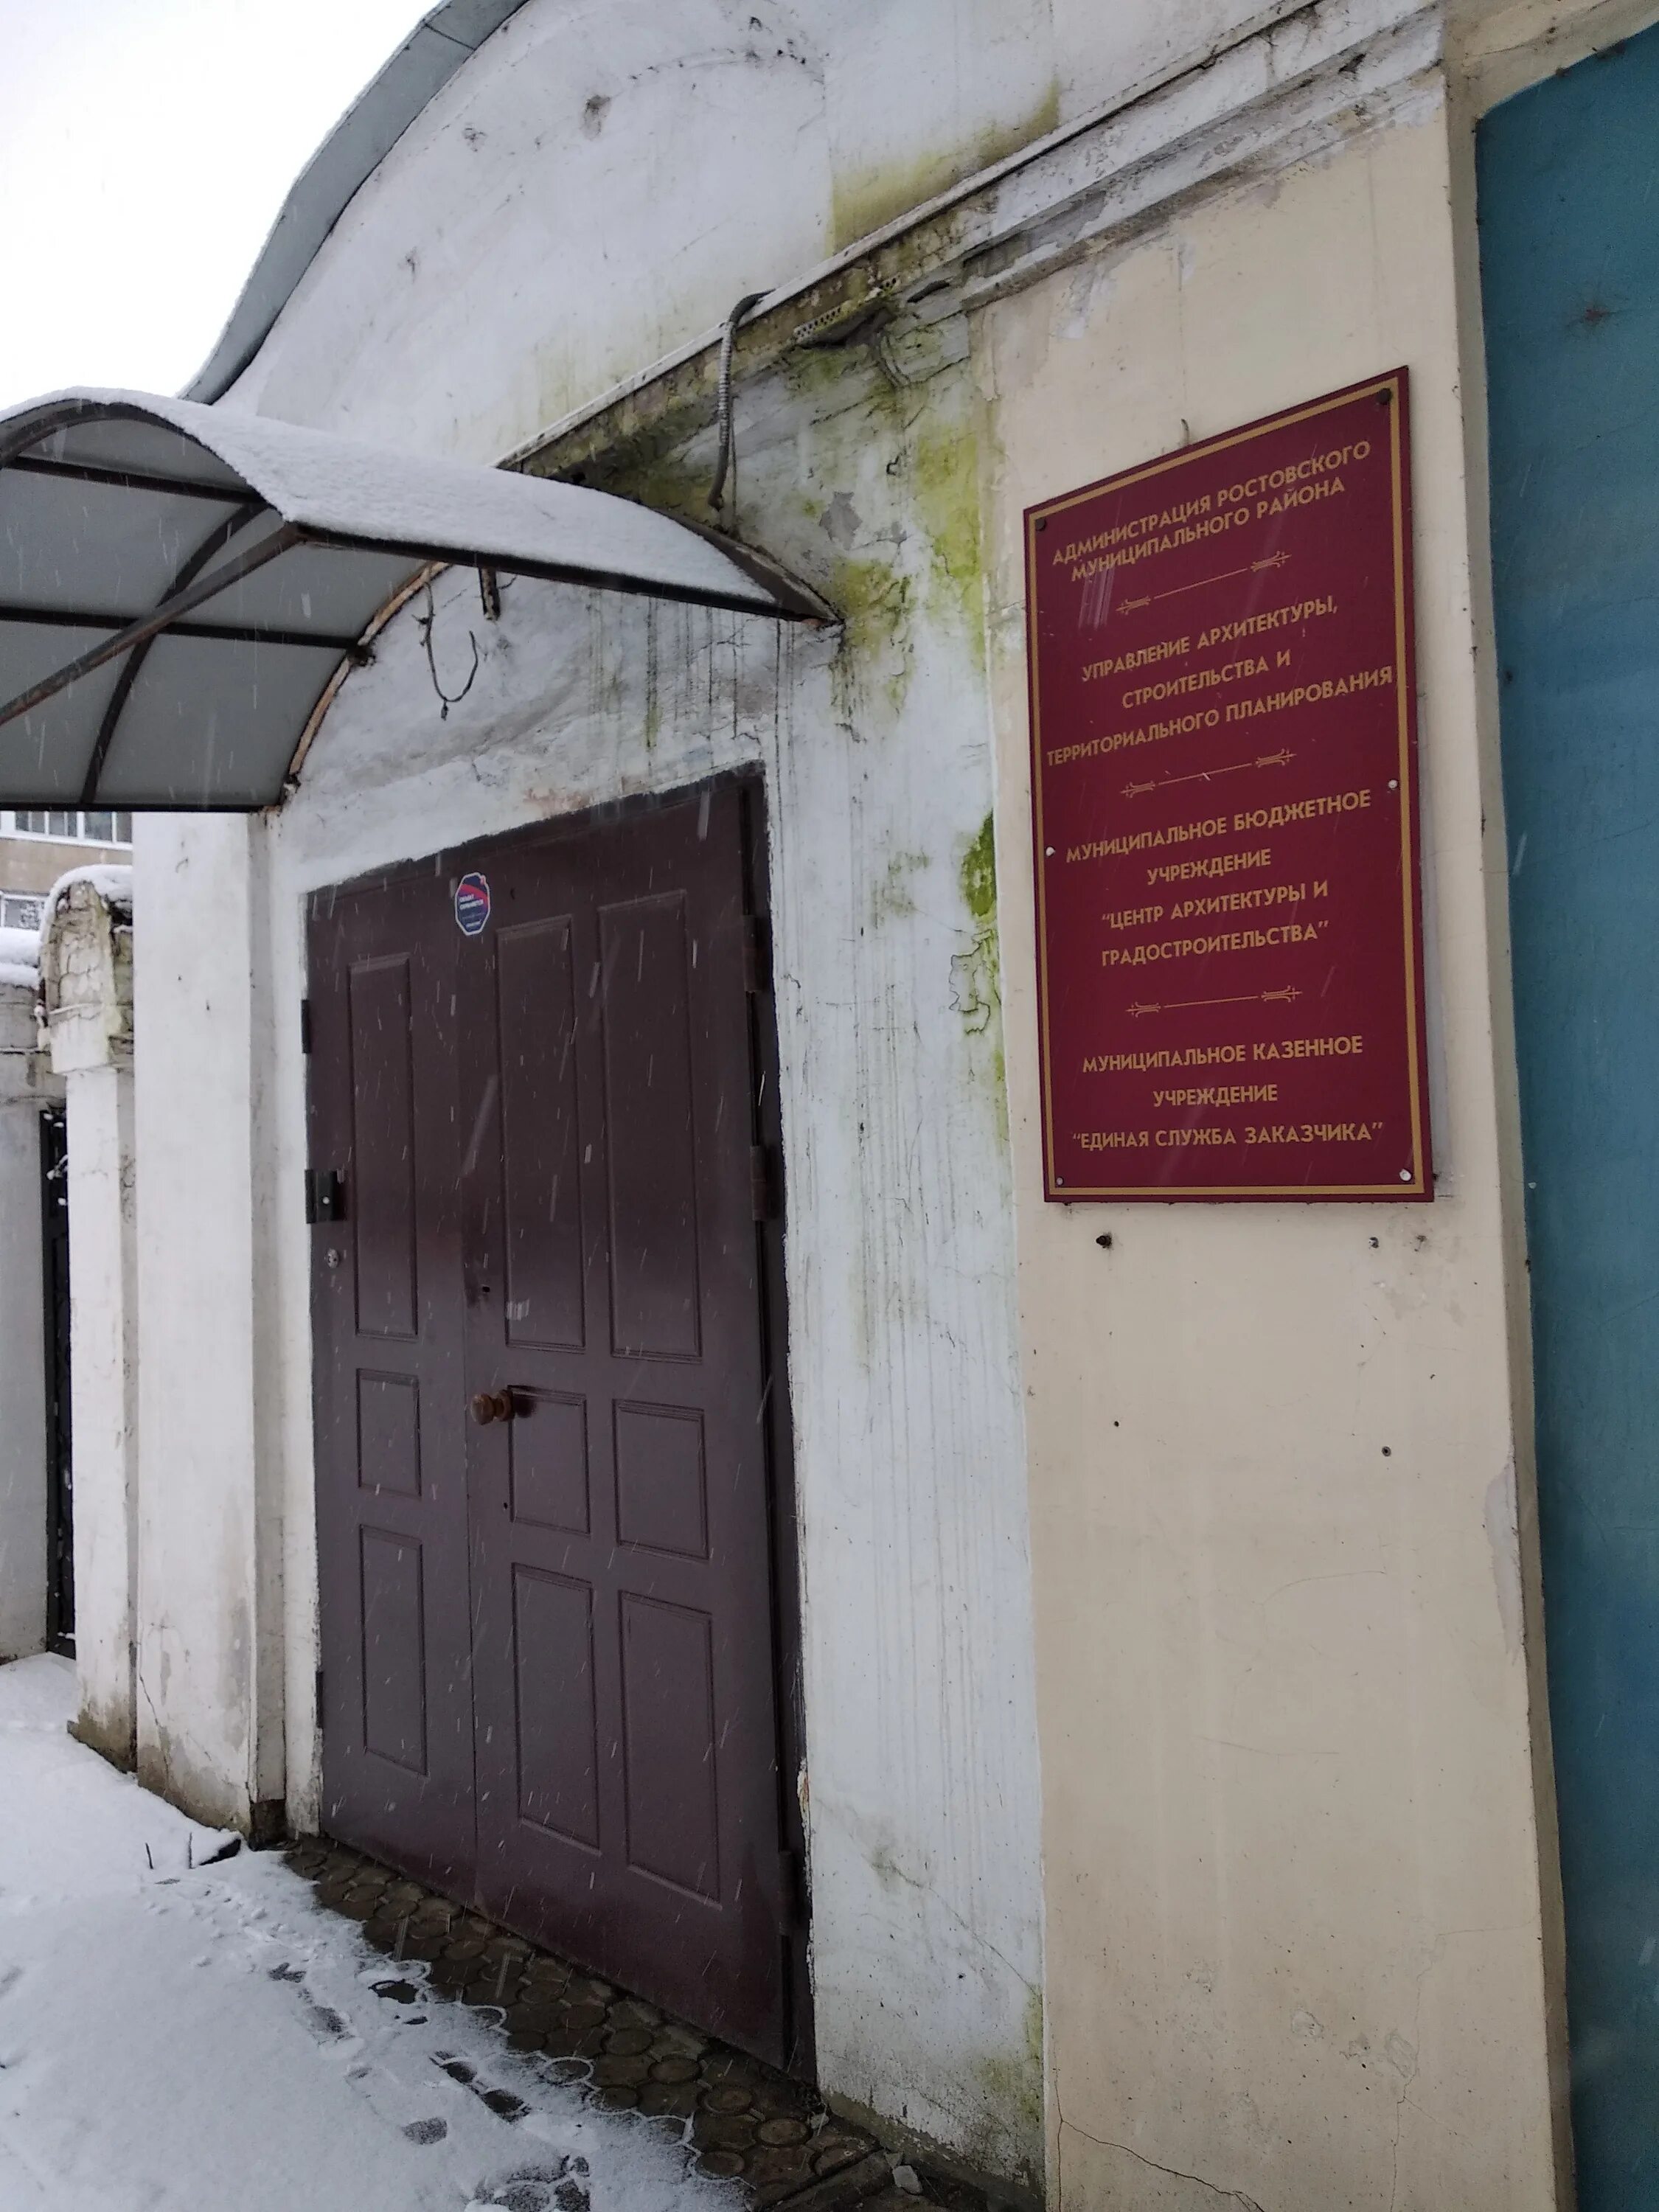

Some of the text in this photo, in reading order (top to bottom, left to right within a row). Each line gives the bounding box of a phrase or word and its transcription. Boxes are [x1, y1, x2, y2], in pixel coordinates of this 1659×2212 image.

[1052, 440, 1371, 566] АДМИНИСТРАЦИЯ РОСТОВСКОГО
[1071, 476, 1346, 582] МУНИЦИПАЛЬНОГО РАЙОНА
[1081, 594, 1338, 682] УПРАВЛЕНИЕ АРХИТЕКТУРЫ,
[1121, 649, 1291, 709] СТРОИТЕЛЬСТВА И
[1046, 665, 1393, 766] ТЕРРИТОРИАЛЬНОГО ПЛАНИРОВАНИЯ
[1065, 789, 1371, 863] МУНИЦИПАЛЬНОЕ БЮДЖЕТНОЕ
[1147, 848, 1271, 886] УЧРЕЖДЕНИЕ
[1170, 883, 1307, 920] АРХИТЕКТУРЫ
[1313, 880, 1329, 897] И
[1082, 1035, 1363, 1074] МУНИЦИПАЛЬНОЕ КАЗЕННОЕ
[1152, 1084, 1278, 1107] УЧРЕЖДЕНИЕ
[1155, 1129, 1236, 1146] СЛУЖБА
